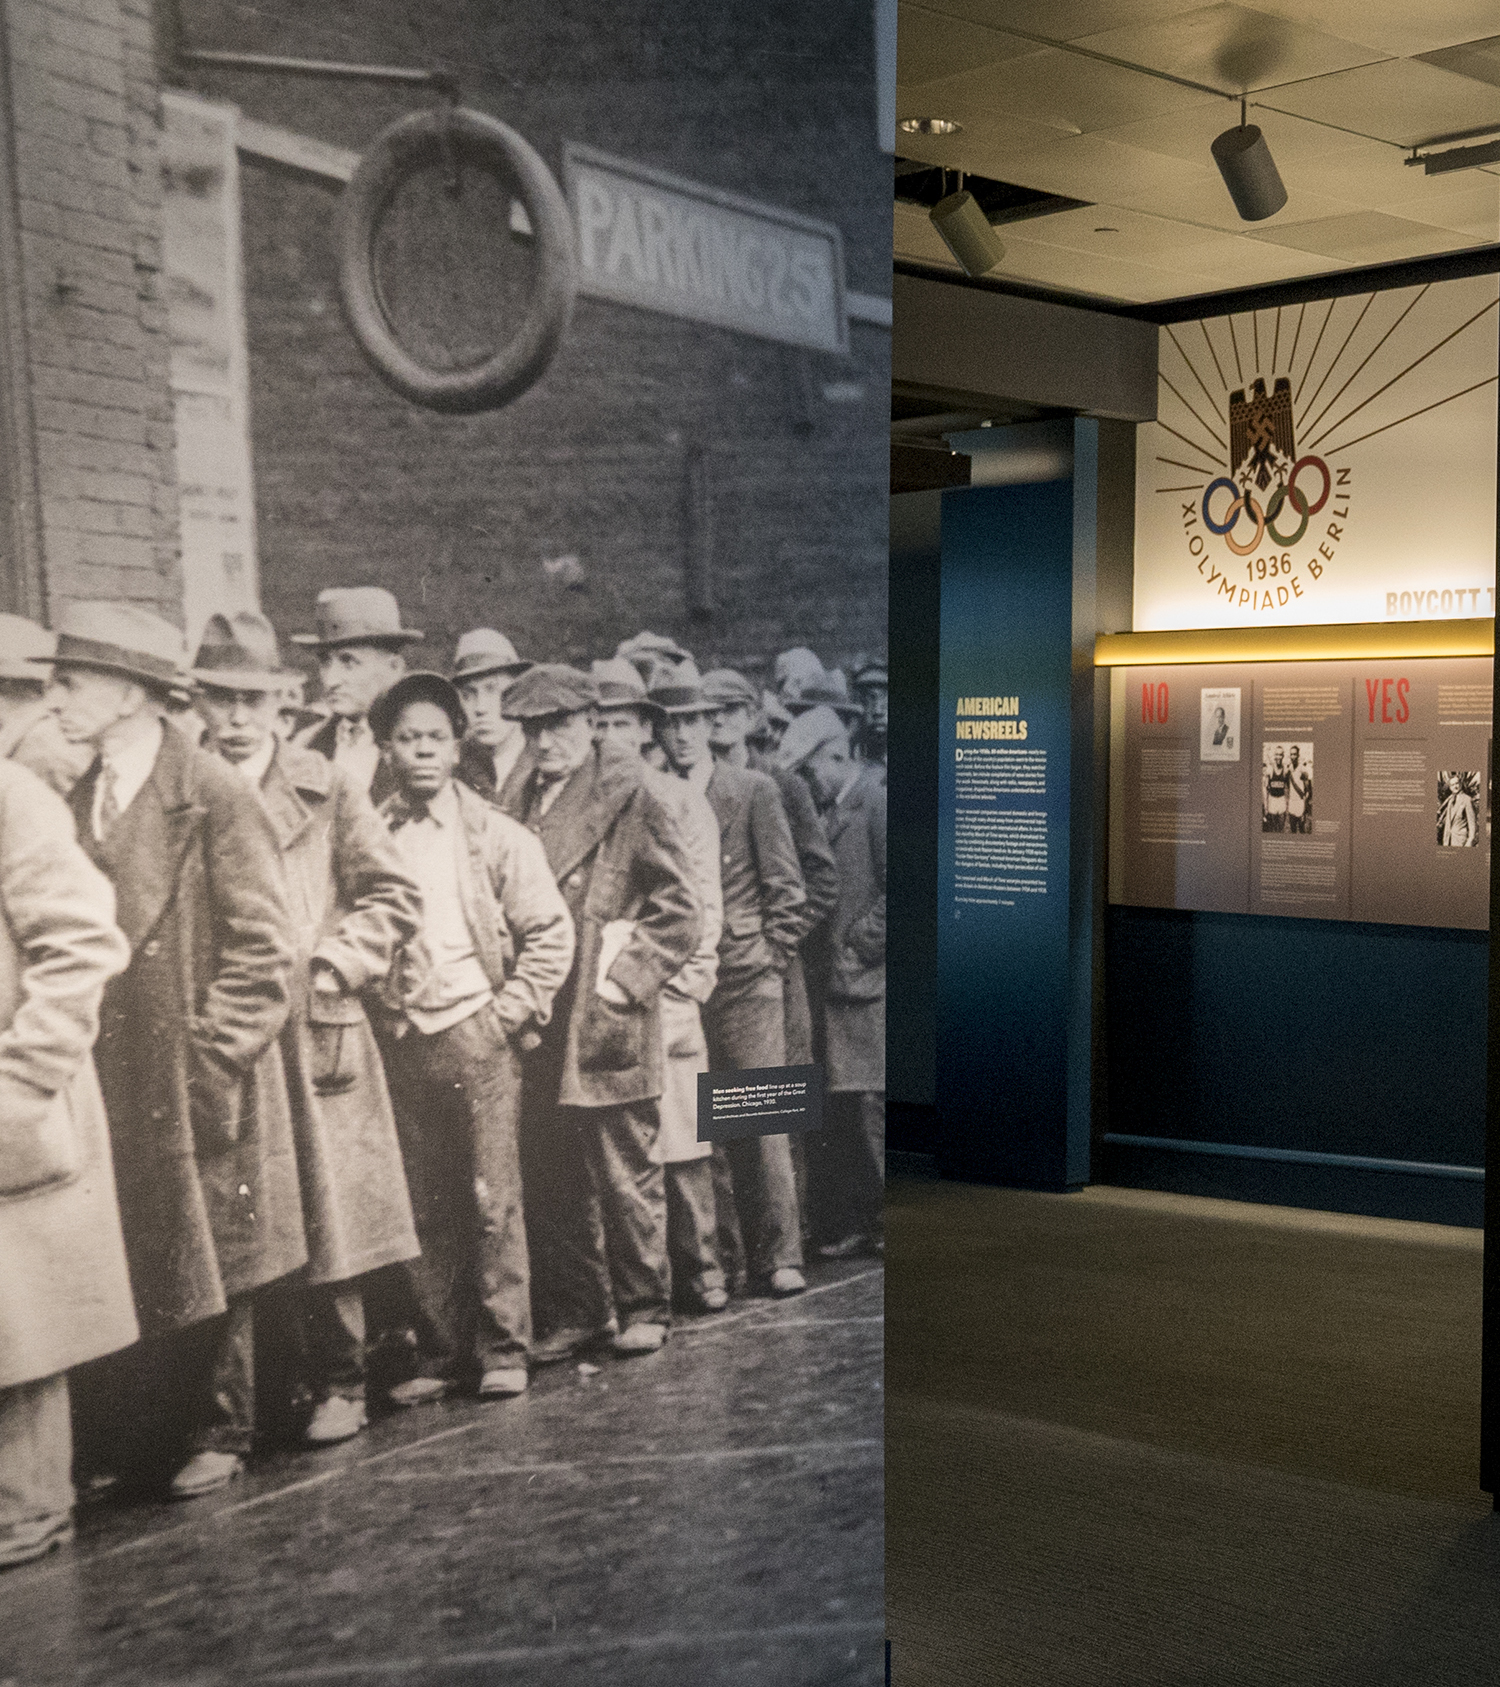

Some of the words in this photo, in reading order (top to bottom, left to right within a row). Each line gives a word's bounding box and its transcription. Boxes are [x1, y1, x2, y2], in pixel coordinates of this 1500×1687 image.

[576, 172, 764, 311] PARKING
[1189, 535, 1304, 611] OLYMPIADE
[1307, 468, 1352, 580] BERLIN
[1246, 552, 1292, 582] 1936
[1386, 588, 1481, 616] BOYCOTT
[956, 696, 1020, 716] AMERICAN
[1142, 682, 1169, 724] NO
[1366, 678, 1410, 724] YES
[956, 720, 1028, 740] NEWSREELS
